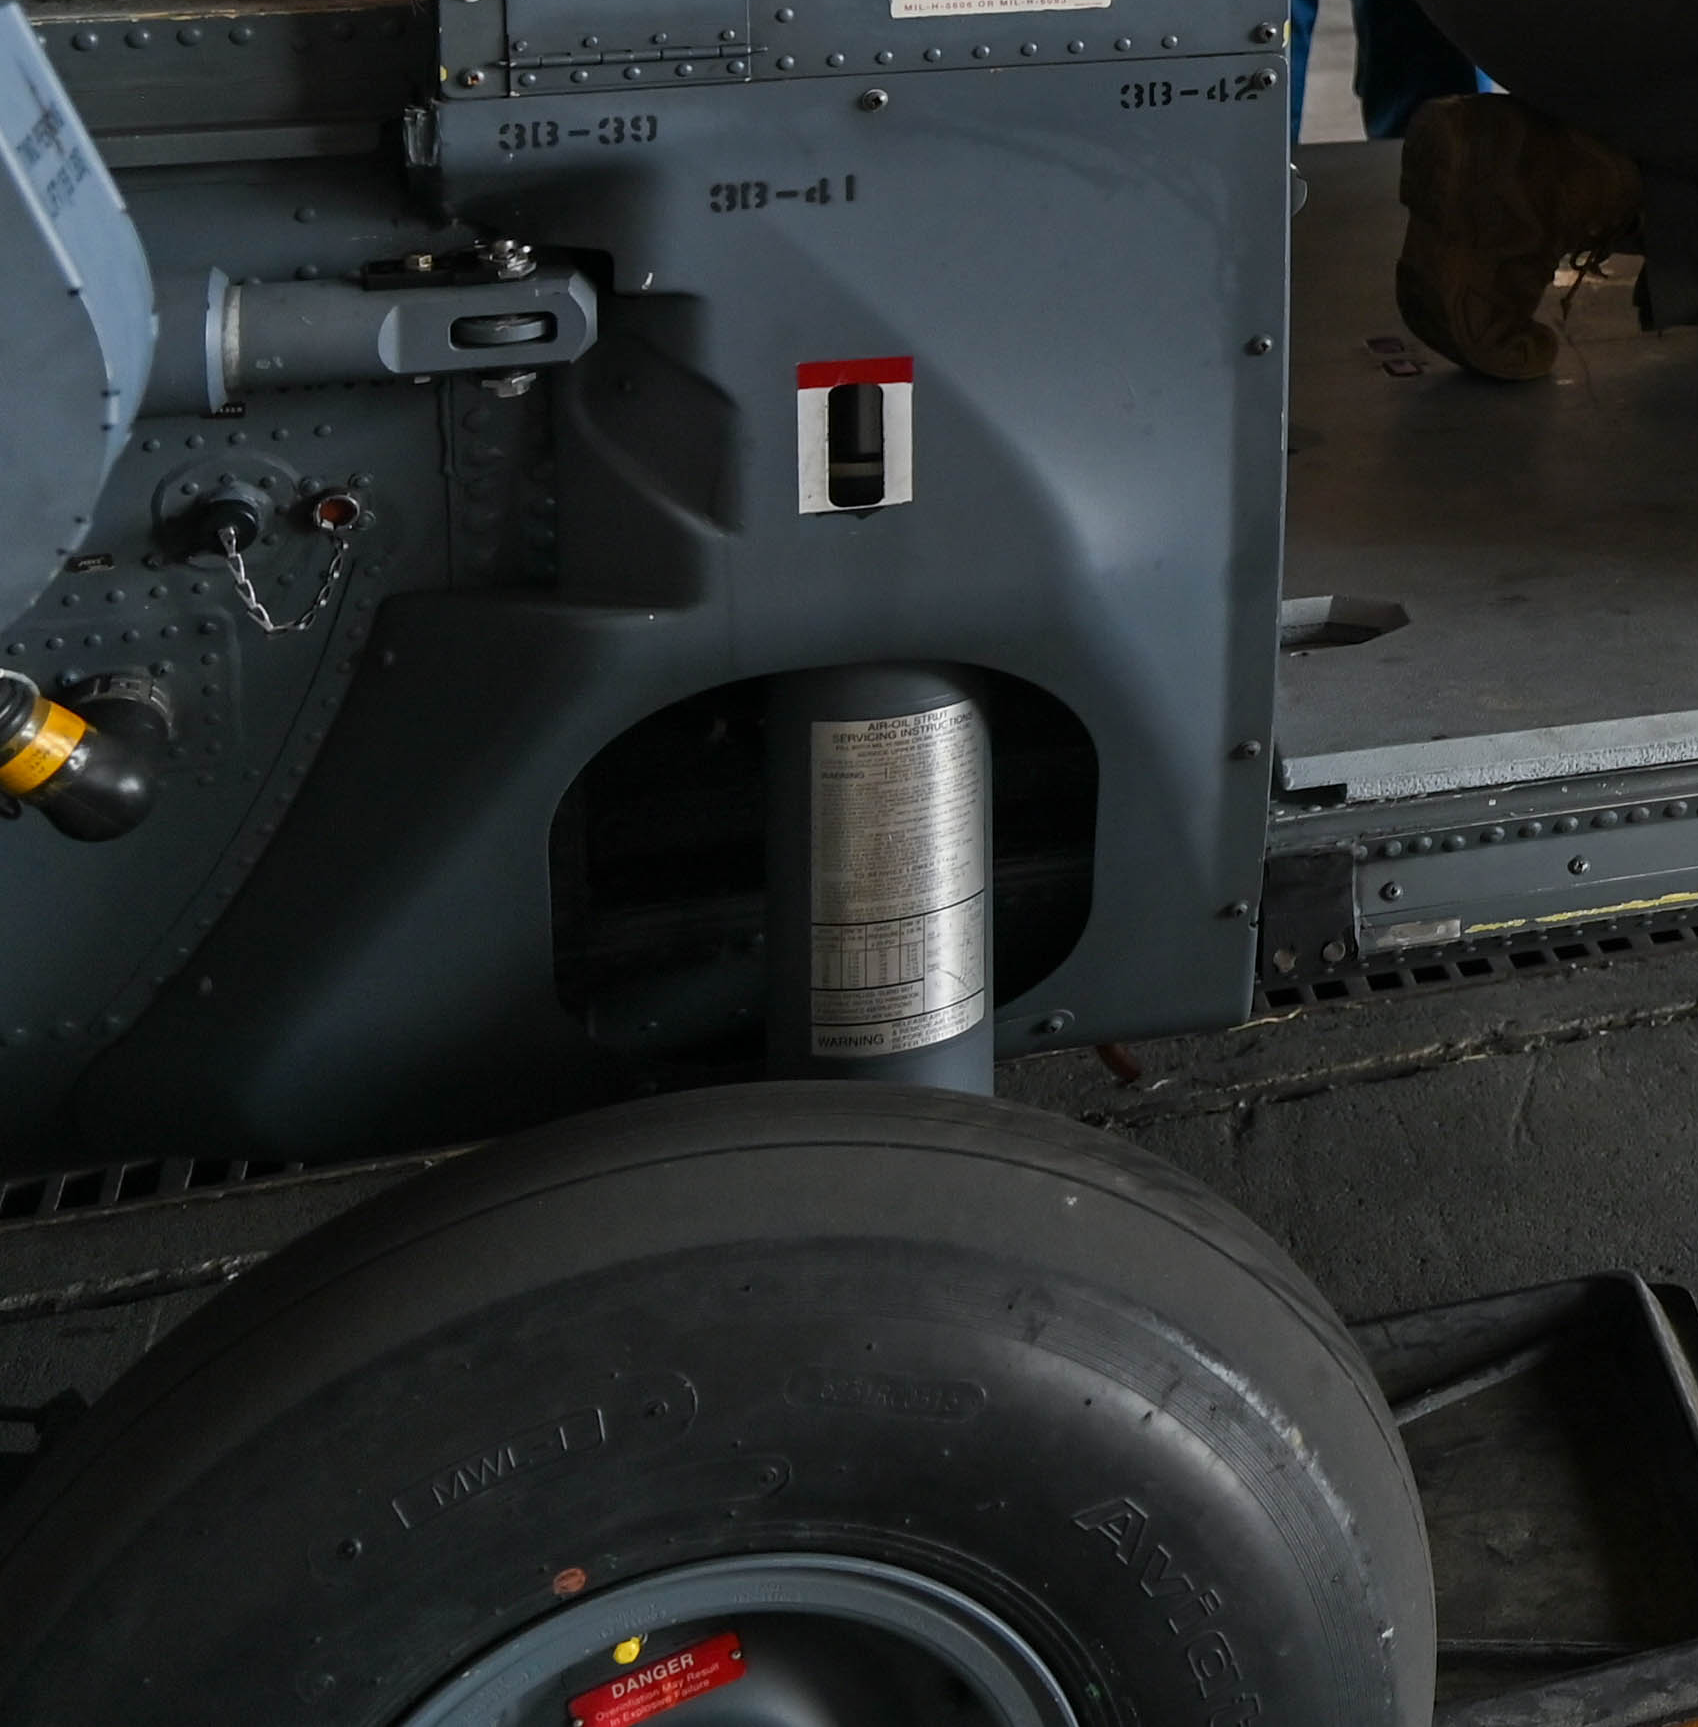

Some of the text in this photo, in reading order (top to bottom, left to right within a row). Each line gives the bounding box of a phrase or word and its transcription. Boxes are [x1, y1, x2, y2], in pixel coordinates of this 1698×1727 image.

[978, 0, 994, 8] OR
[1120, 76, 1258, 109] 3B-42
[499, 115, 657, 150] 3B-39
[710, 174, 855, 213] 3B-41
[833, 730, 897, 744] SERVICING
[868, 721, 911, 732] AIR-OIL
[817, 1034, 885, 1049] WARNING
[611, 1653, 695, 1699] DANGER
[661, 1677, 684, 1693] May
[687, 1662, 720, 1682] Result
[623, 1694, 673, 1724] Explosive
[674, 1679, 710, 1698] Failure
